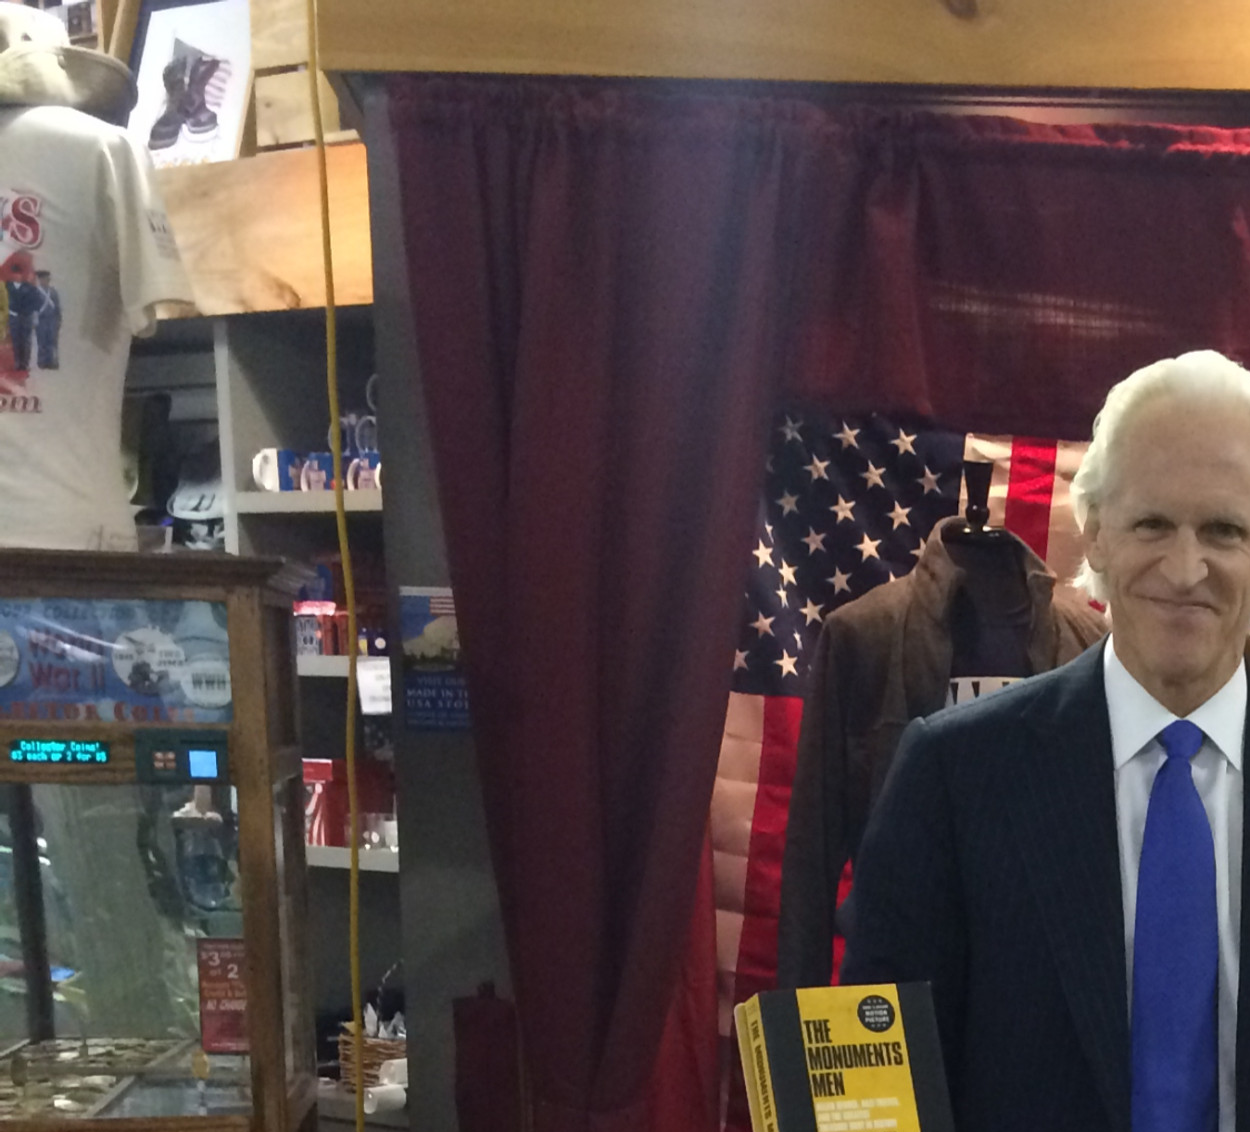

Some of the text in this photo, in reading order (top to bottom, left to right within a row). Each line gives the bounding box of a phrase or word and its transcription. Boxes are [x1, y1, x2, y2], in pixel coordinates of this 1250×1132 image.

[804, 1019, 832, 1044] THE
[807, 1041, 903, 1070] MONUMENTS
[755, 1045, 772, 1119] MONUMENTS
[811, 1072, 845, 1098] MEN
